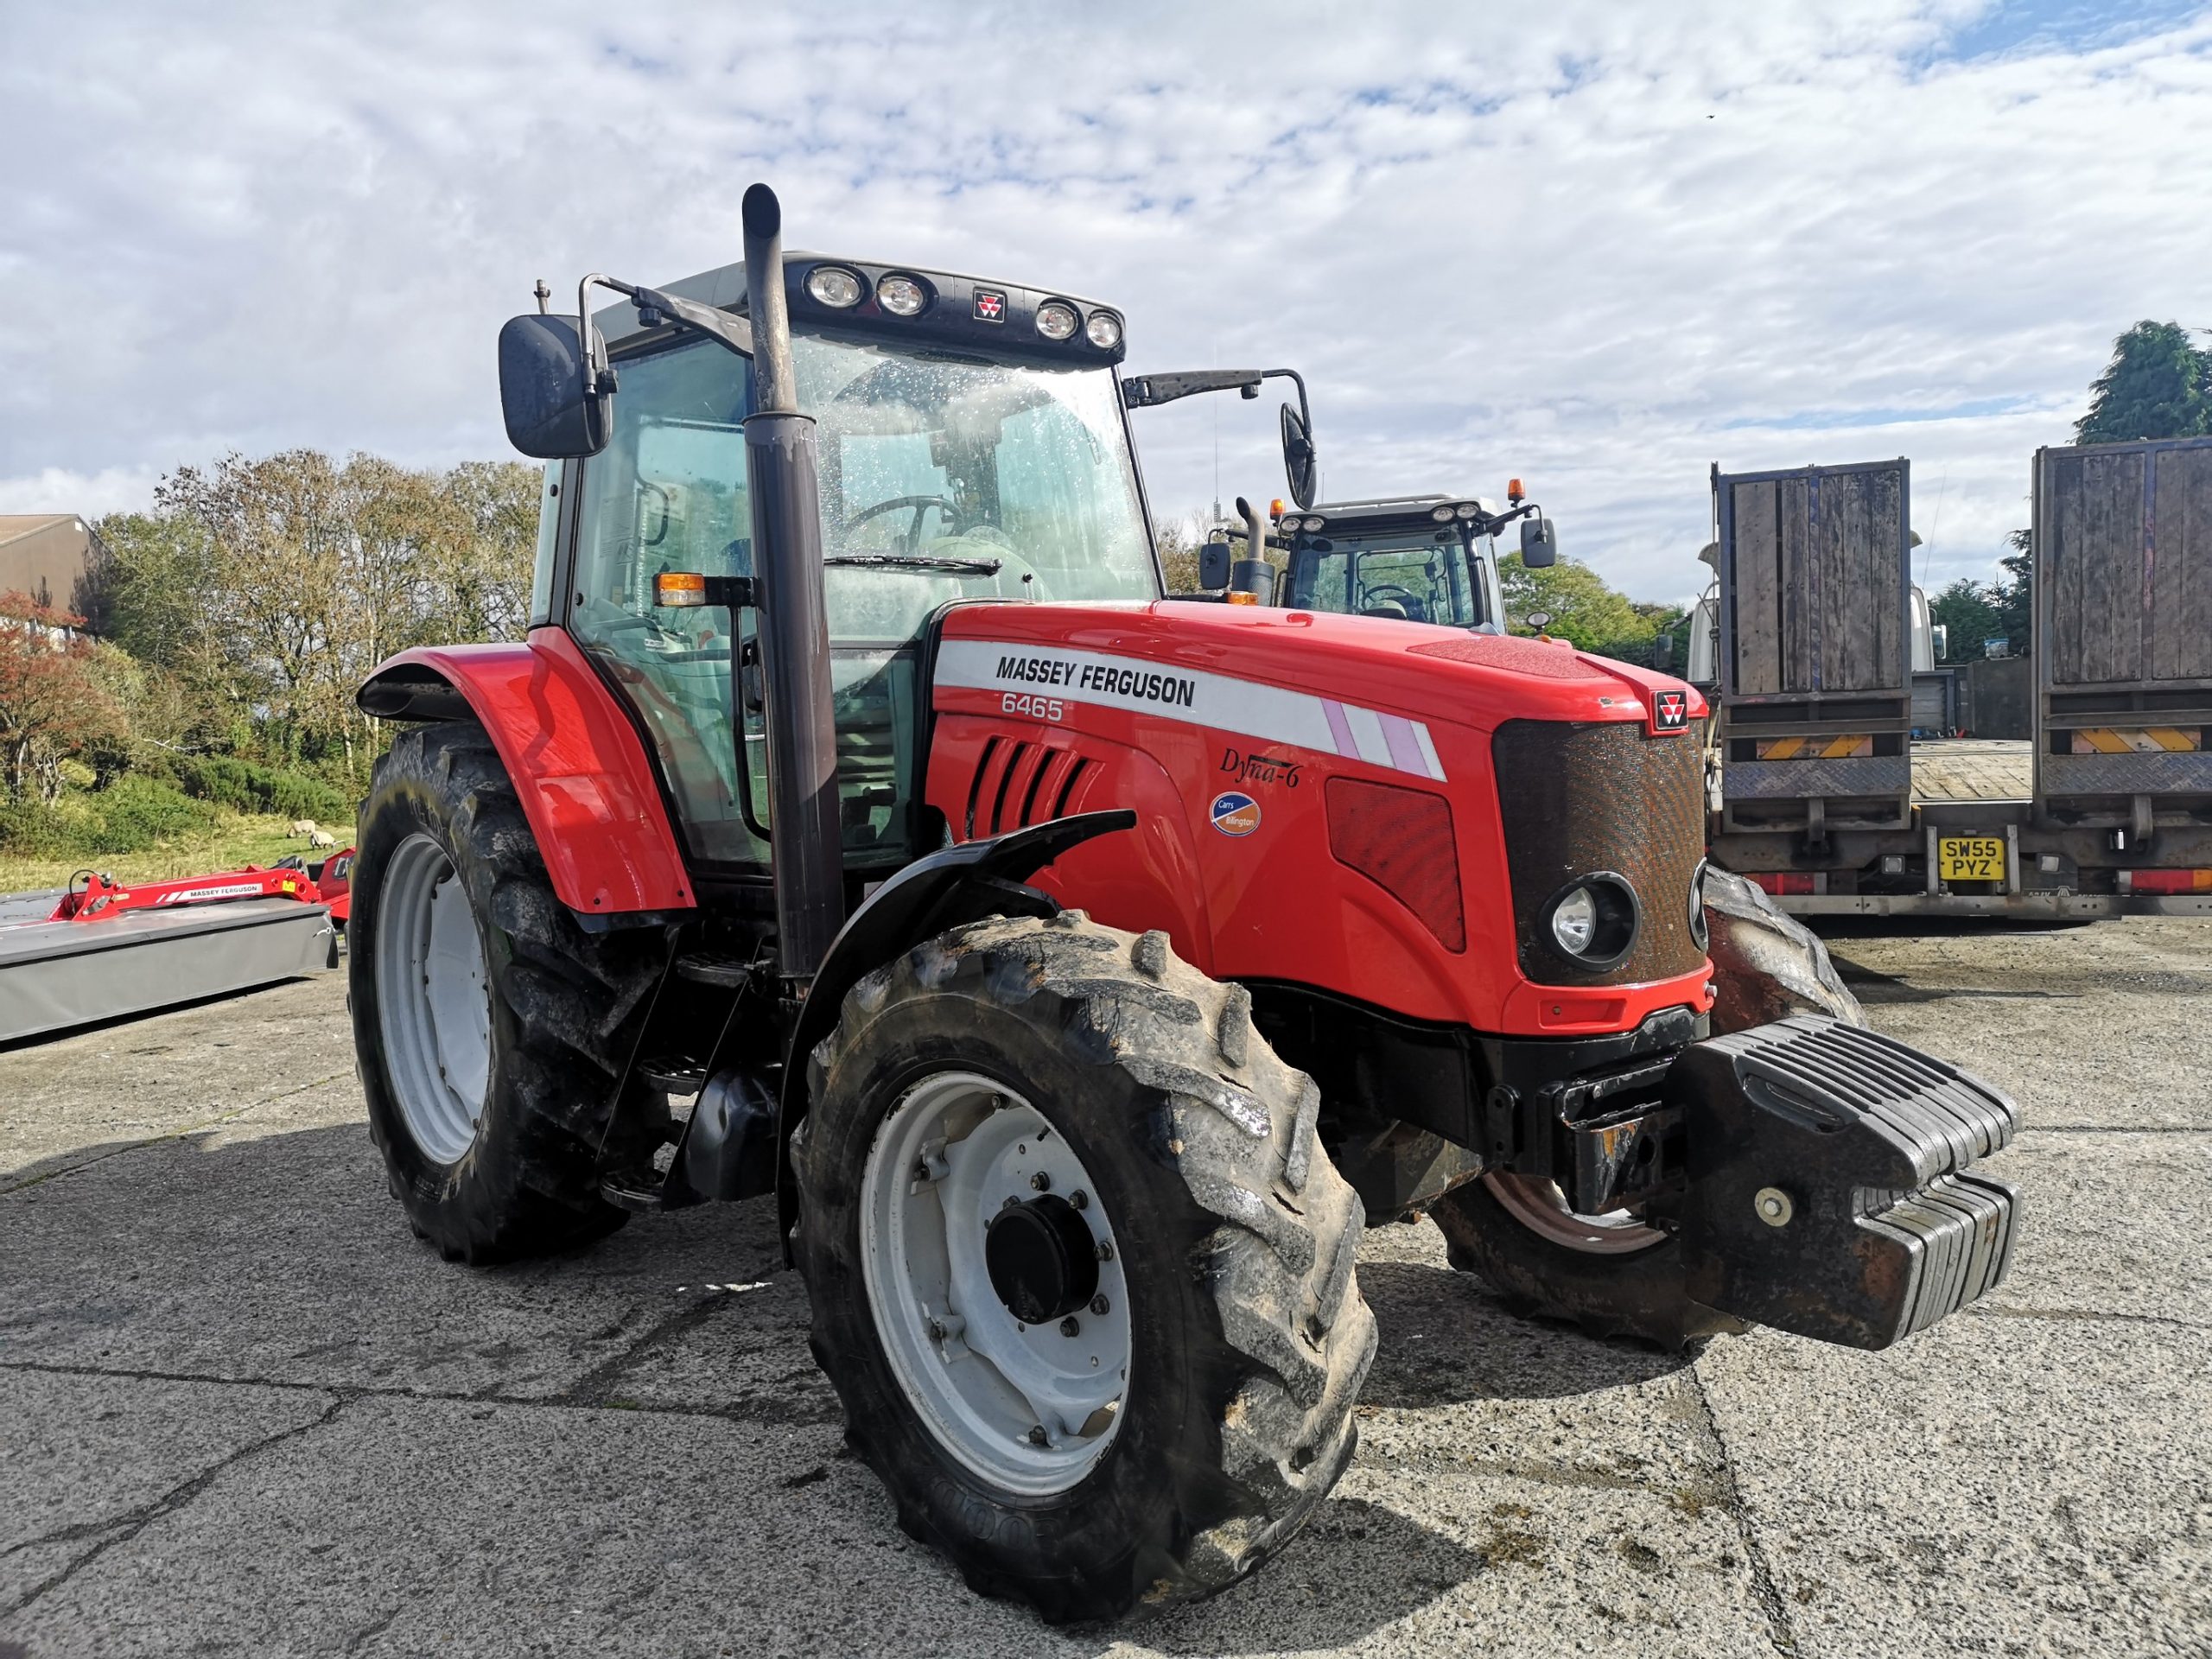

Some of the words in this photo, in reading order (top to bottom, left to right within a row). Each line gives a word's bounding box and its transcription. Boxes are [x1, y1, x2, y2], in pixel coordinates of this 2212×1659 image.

[996, 657, 1077, 686] MASSEY
[1079, 664, 1196, 708] FERGUSON
[1001, 692, 1064, 721] 6465
[1219, 747, 1304, 788] Dyna-6
[1218, 799, 1234, 810] Carrs
[1225, 816, 1255, 828] Billington
[1945, 841, 1997, 857] SW55
[1953, 860, 1991, 875] PYZ
[221, 886, 257, 894] FERGUSON
